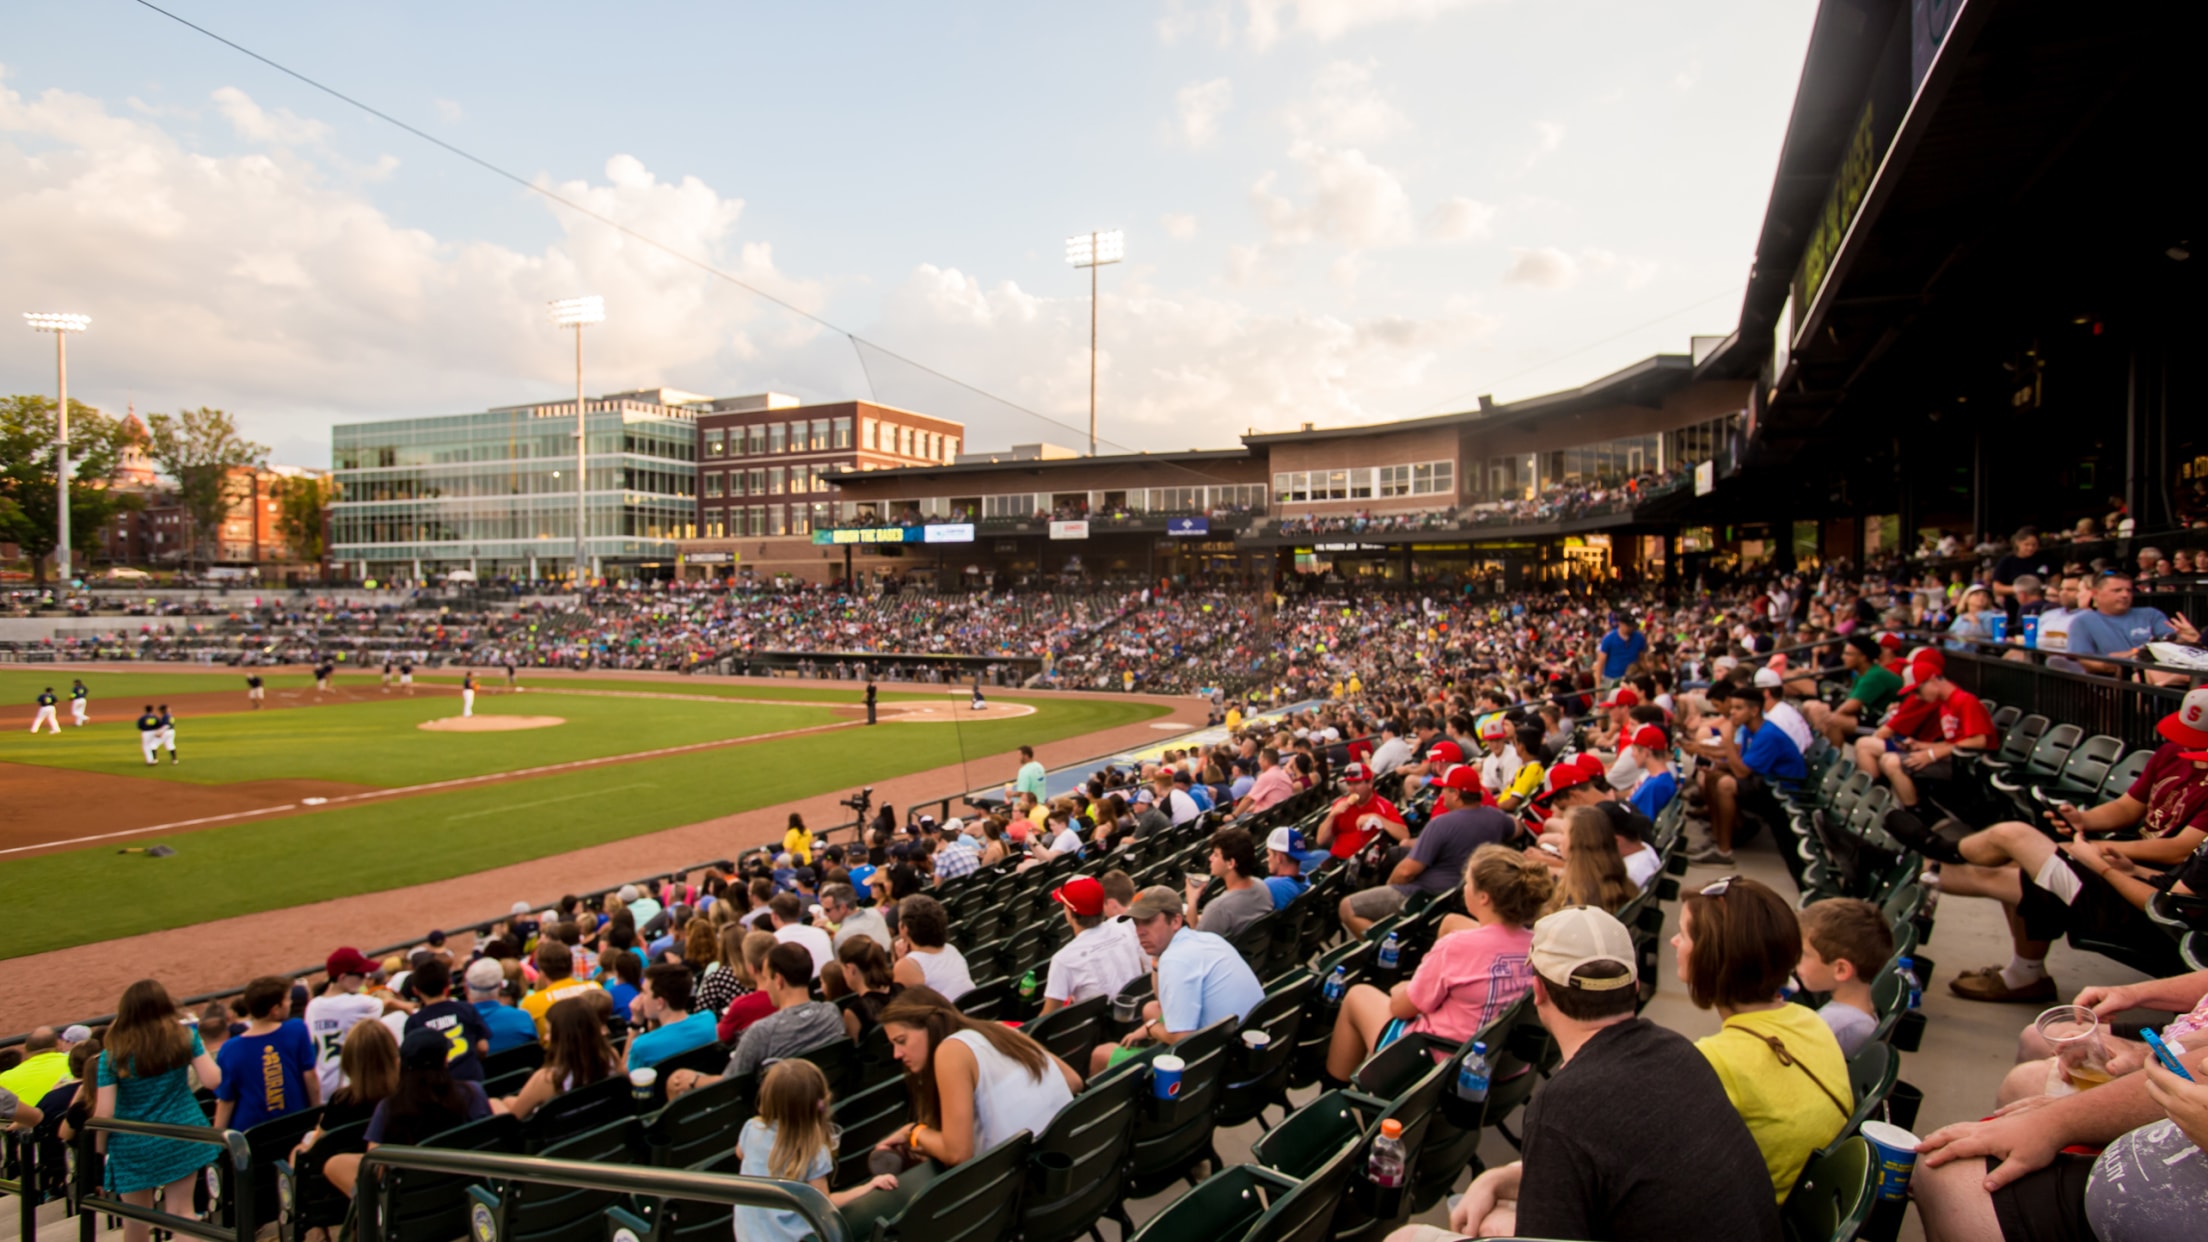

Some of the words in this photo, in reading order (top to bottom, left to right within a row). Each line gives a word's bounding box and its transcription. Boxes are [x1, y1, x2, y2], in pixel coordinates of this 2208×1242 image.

[2187, 705, 2203, 722] S
[314, 1019, 339, 1031] TEBOW
[263, 1062, 286, 1113] DURANT
